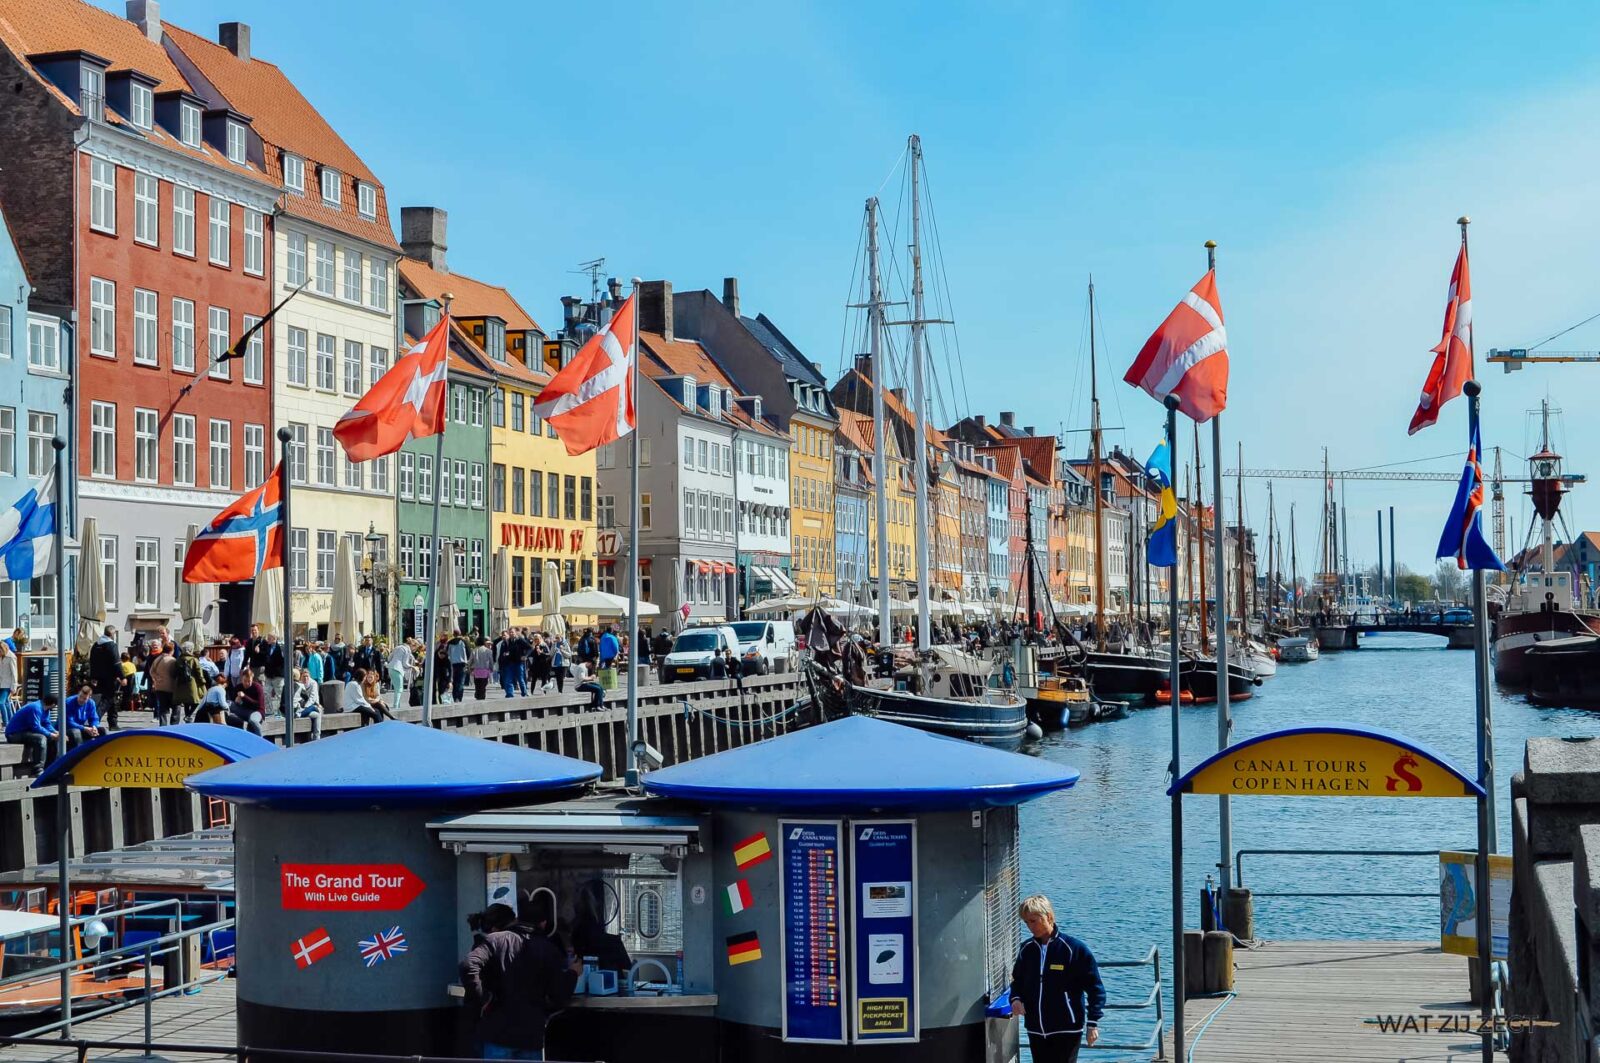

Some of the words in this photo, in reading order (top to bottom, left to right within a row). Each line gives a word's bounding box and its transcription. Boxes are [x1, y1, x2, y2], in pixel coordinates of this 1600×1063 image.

[501, 523, 565, 553] NYHAVN
[570, 529, 584, 554] 17
[598, 534, 617, 554] 17
[104, 756, 153, 768] CANAL
[156, 756, 204, 769] TOURS
[1234, 759, 1299, 772] CANAL
[1304, 759, 1367, 773] TOURS
[103, 771, 193, 784] COPENHAG
[1232, 777, 1370, 791] COPENHAGEN
[285, 872, 310, 887] The
[315, 874, 363, 888] Grand
[368, 874, 405, 888] Tour
[304, 892, 325, 902] With
[328, 892, 348, 902] Live
[351, 892, 380, 902] Guide
